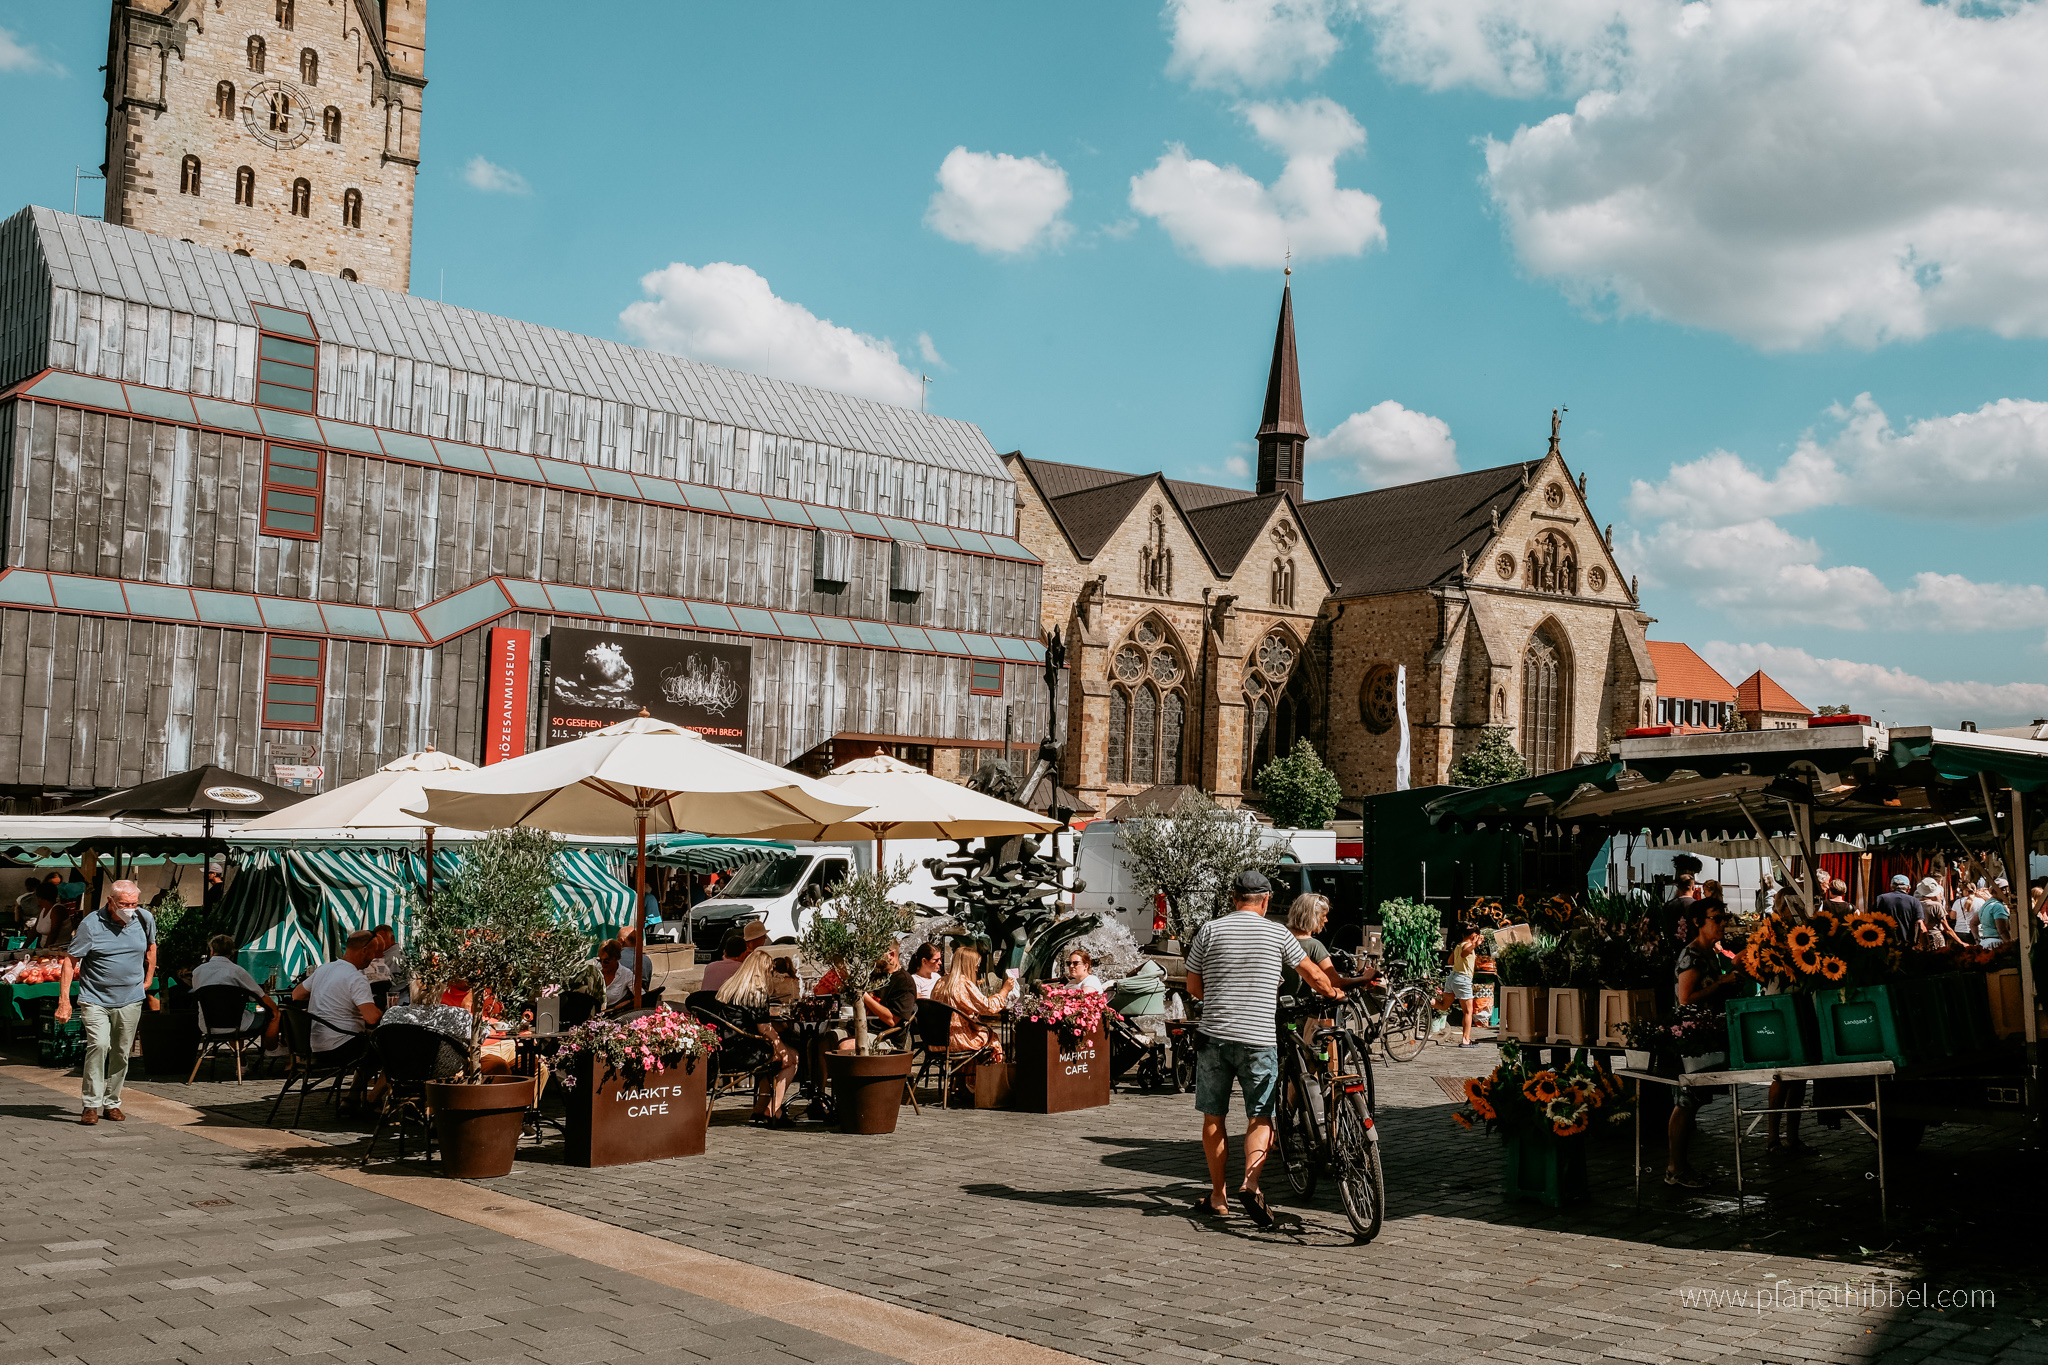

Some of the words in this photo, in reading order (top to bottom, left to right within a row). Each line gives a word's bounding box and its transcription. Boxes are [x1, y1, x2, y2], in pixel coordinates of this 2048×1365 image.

[552, 717, 564, 727] SO
[566, 718, 602, 728] GESEHEN
[719, 728, 743, 737] BRECH
[552, 729, 569, 739] 21.5.
[1059, 1050, 1089, 1063] MARKT
[1089, 1049, 1096, 1059] 5
[1065, 1062, 1089, 1076] CAFÉ
[616, 1086, 670, 1102] MARKT
[672, 1085, 682, 1097] 5
[627, 1101, 669, 1117] CAFÉ
